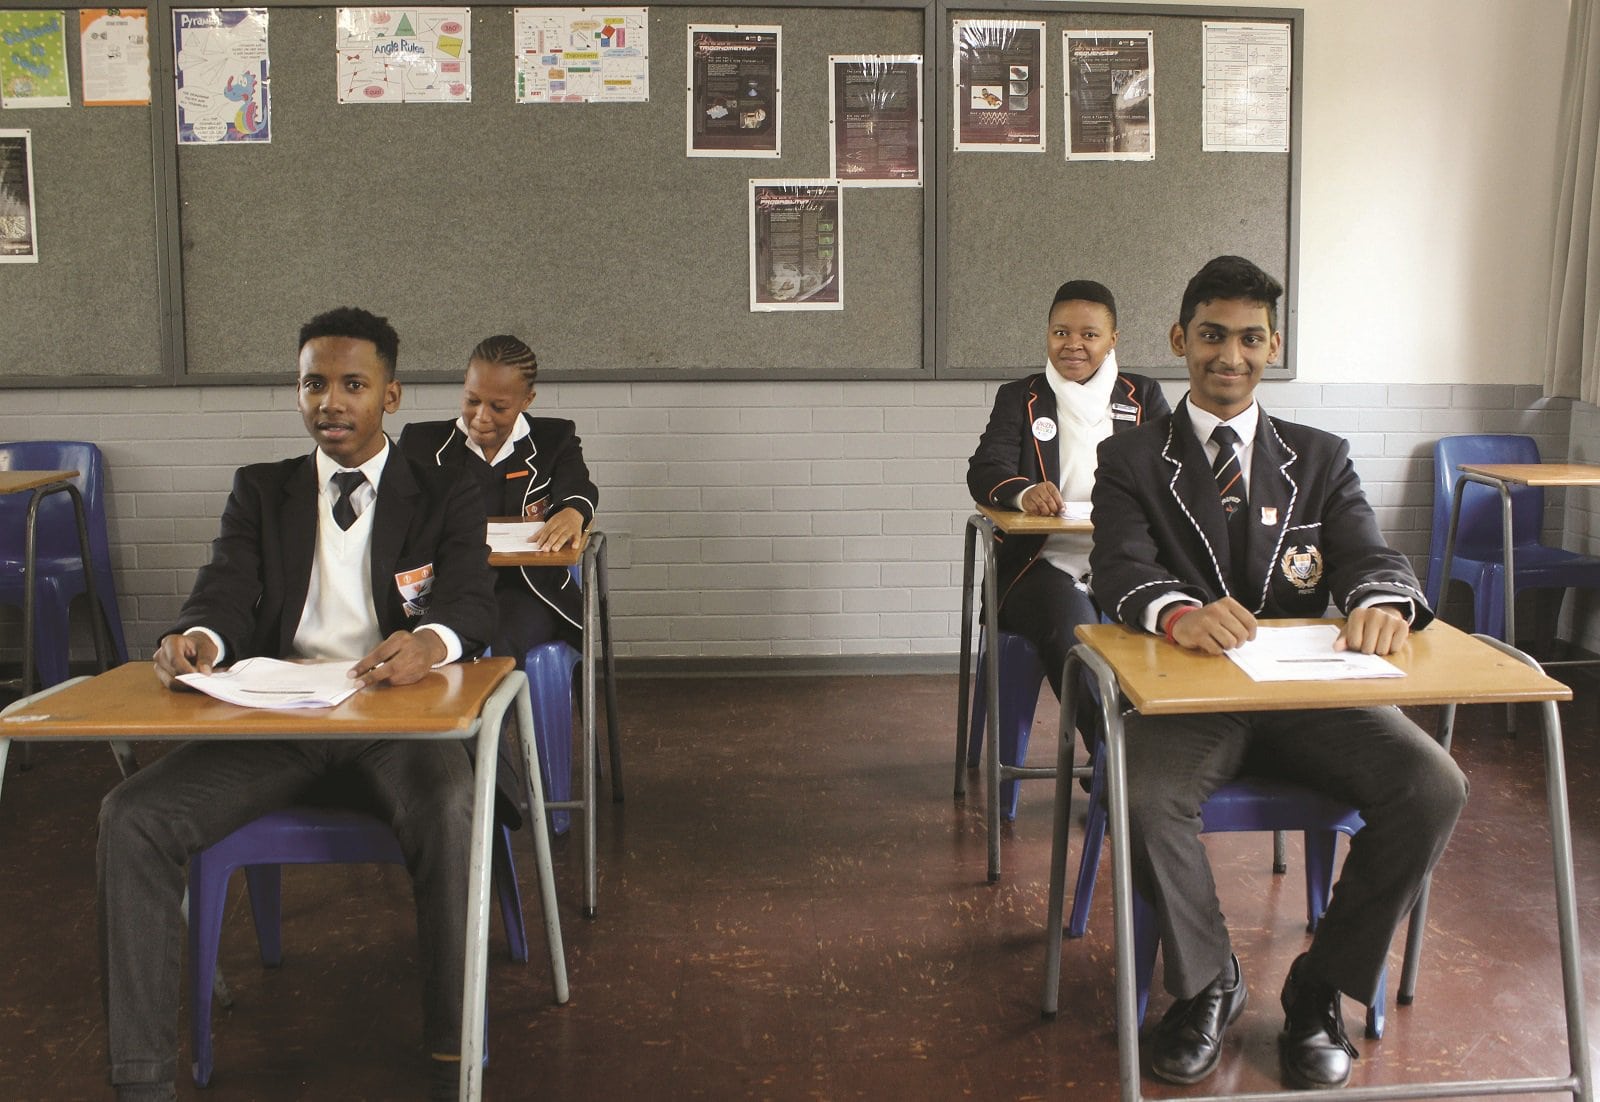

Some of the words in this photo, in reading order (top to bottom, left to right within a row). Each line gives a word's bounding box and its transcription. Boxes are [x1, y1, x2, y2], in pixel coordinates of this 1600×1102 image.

[181, 14, 223, 28] Pyramis
[374, 40, 399, 55] Angle
[400, 39, 425, 54] Rules
